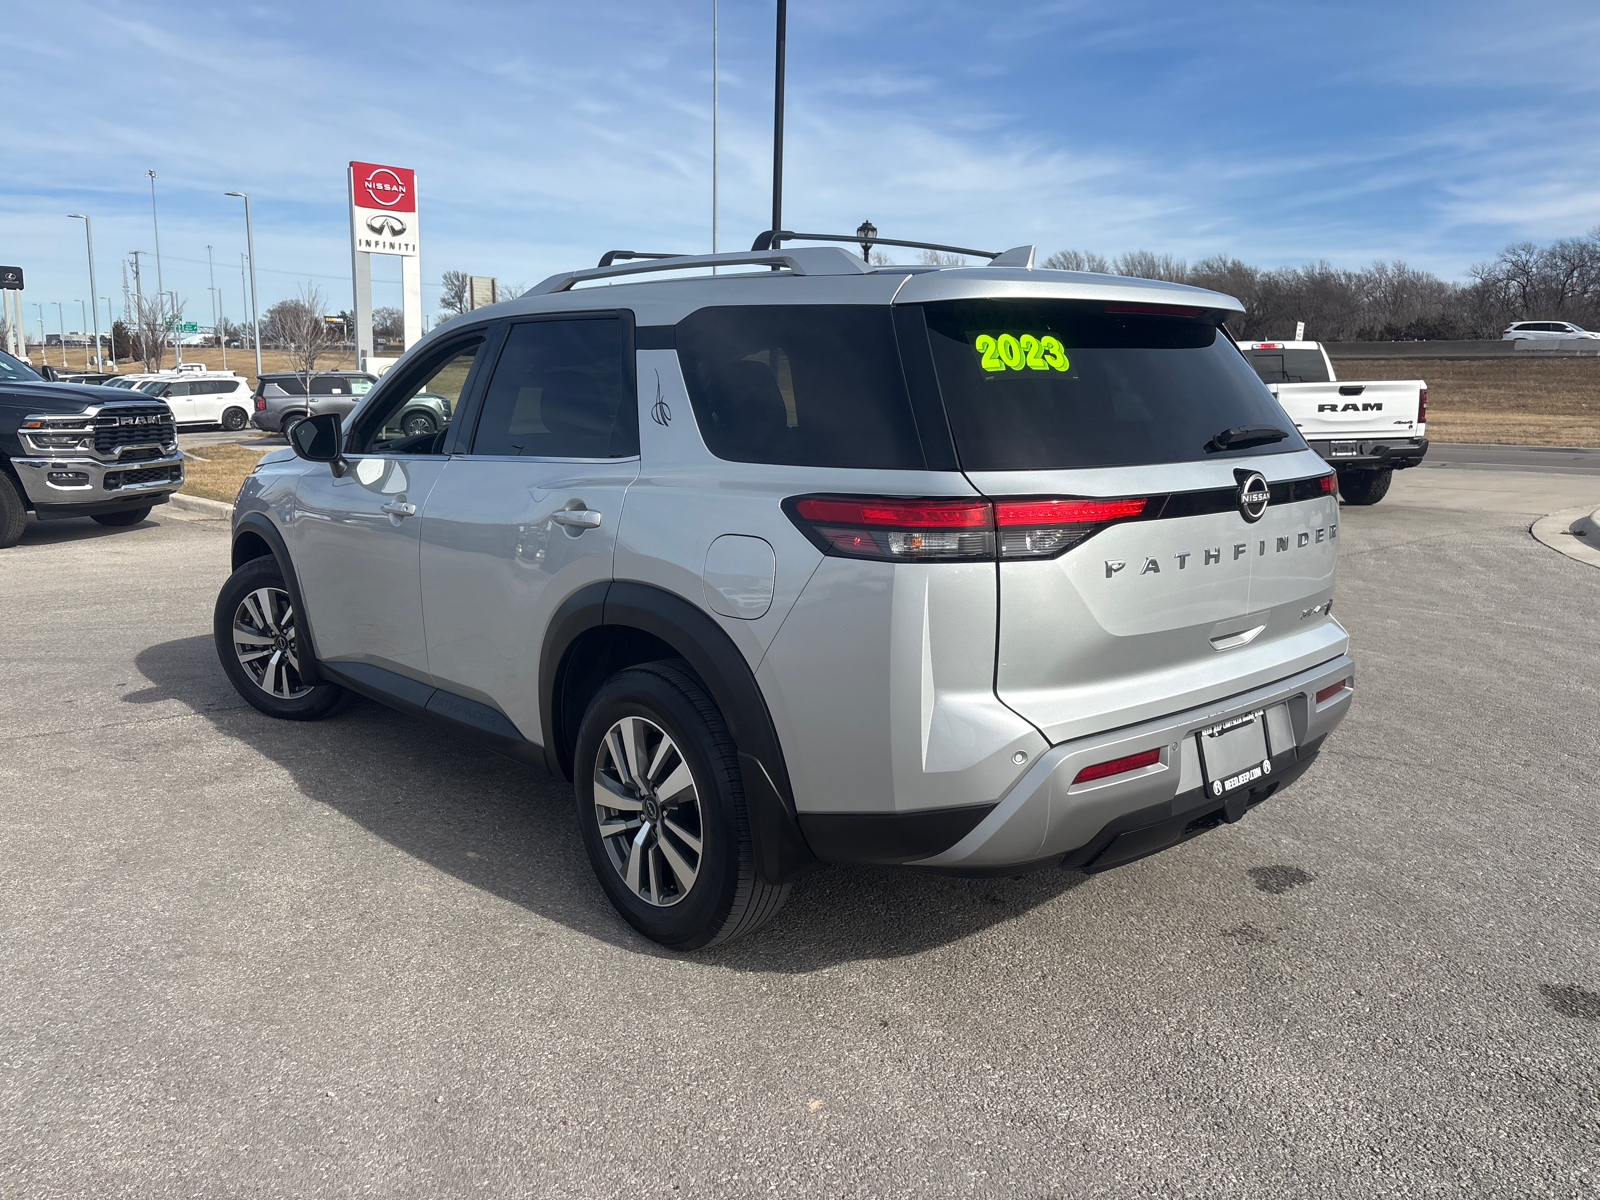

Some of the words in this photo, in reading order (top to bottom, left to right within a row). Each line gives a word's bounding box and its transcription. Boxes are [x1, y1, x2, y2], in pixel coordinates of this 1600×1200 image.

[364, 181, 406, 193] NISSAN
[358, 238, 416, 252] INFINITI
[975, 333, 1070, 372] 2023
[1317, 402, 1383, 413] RAM
[120, 415, 162, 426] RAM
[1241, 491, 1271, 504] NISSAN
[1104, 524, 1338, 579] PATHFINDER
